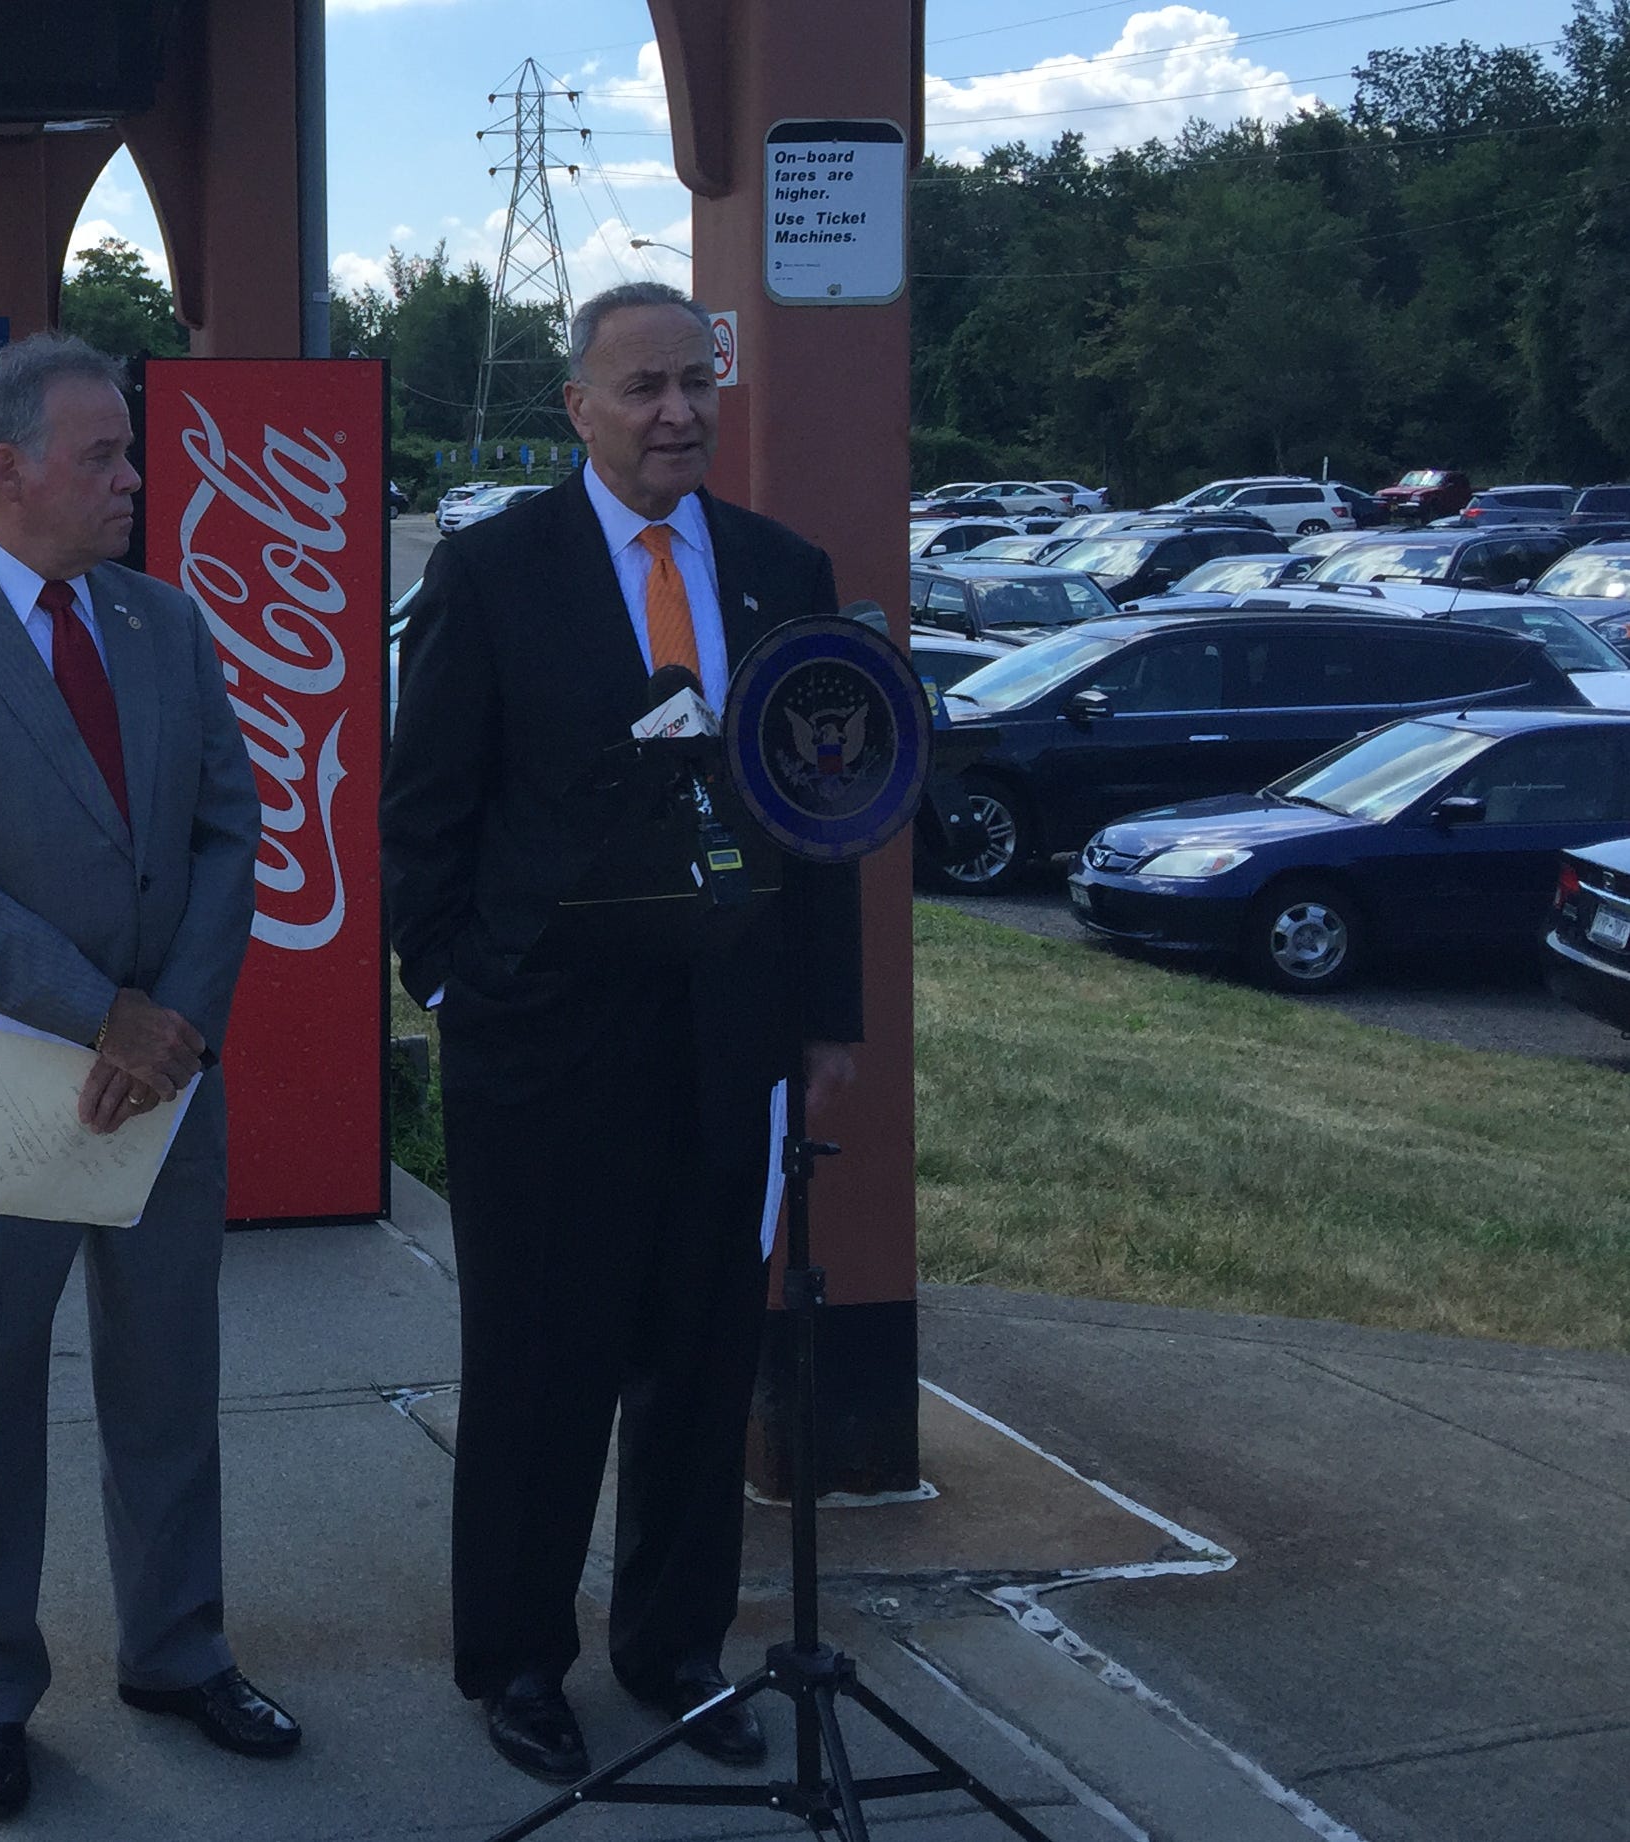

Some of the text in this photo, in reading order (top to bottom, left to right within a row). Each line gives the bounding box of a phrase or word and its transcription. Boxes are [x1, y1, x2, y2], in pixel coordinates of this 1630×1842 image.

[774, 150, 855, 164] On-board
[774, 169, 854, 182] fares are
[774, 187, 830, 203] higher.
[774, 211, 867, 225] Use Ticket
[774, 230, 857, 243] Machines.
[652, 713, 690, 738] rizon
